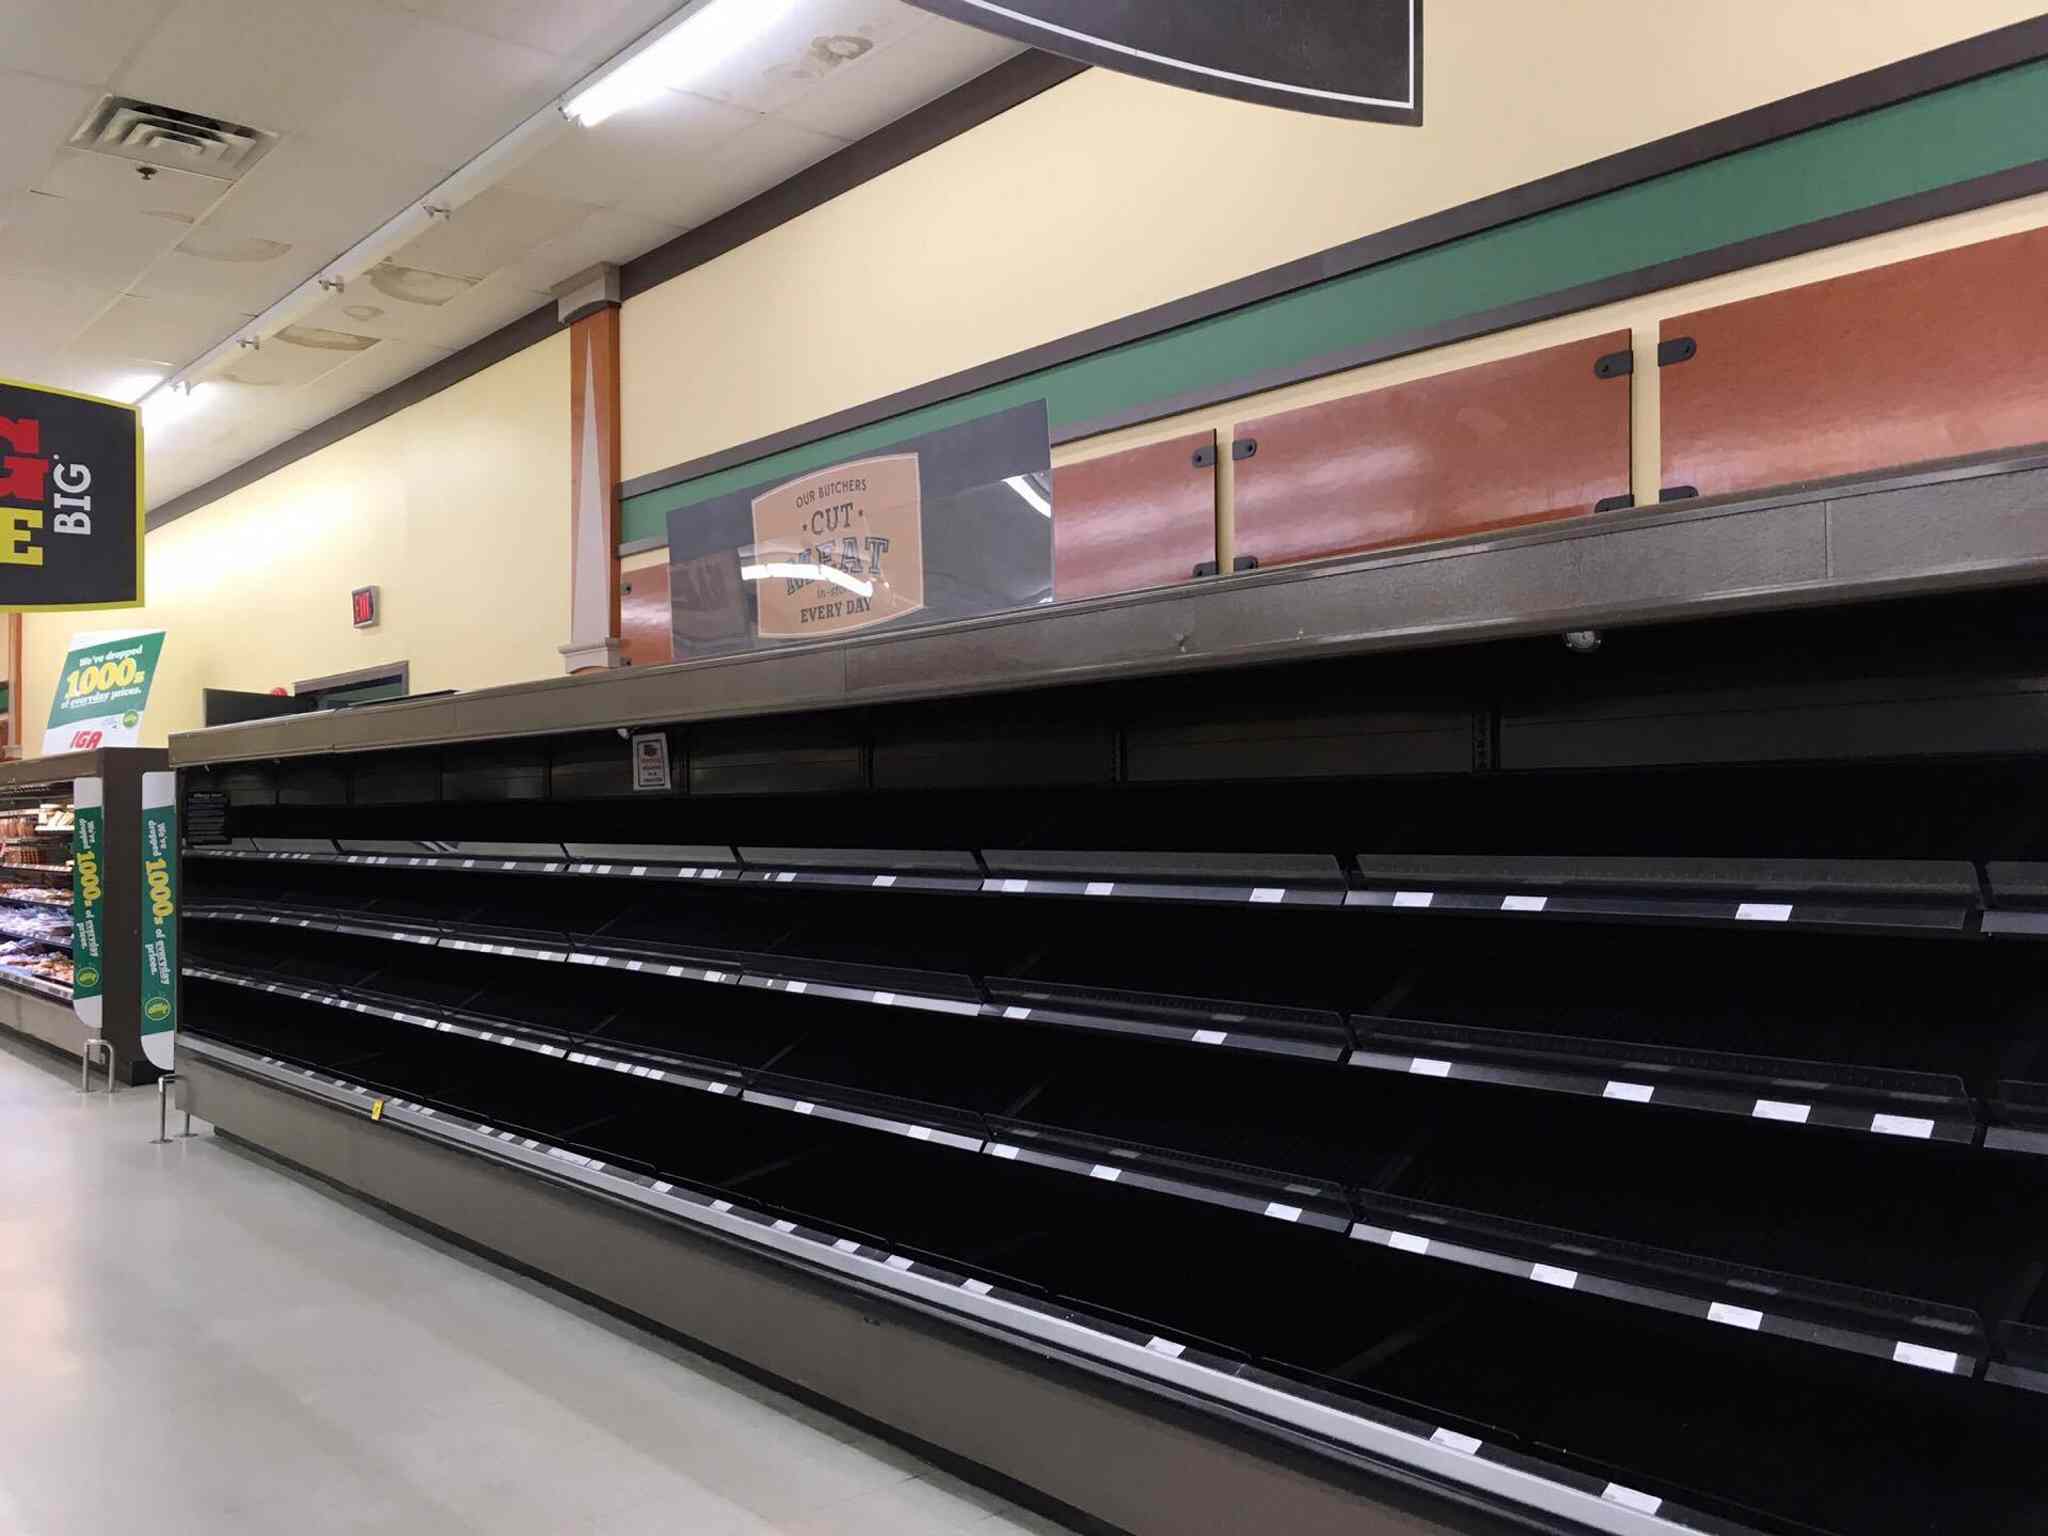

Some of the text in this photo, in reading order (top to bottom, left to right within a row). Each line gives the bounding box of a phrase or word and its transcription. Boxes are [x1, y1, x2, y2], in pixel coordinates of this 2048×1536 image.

[53, 463, 92, 535] BIG
[795, 479, 867, 508] OUR BUTCHERS
[800, 597, 871, 624] EVERY DAY
[70, 731, 103, 750] IGA
